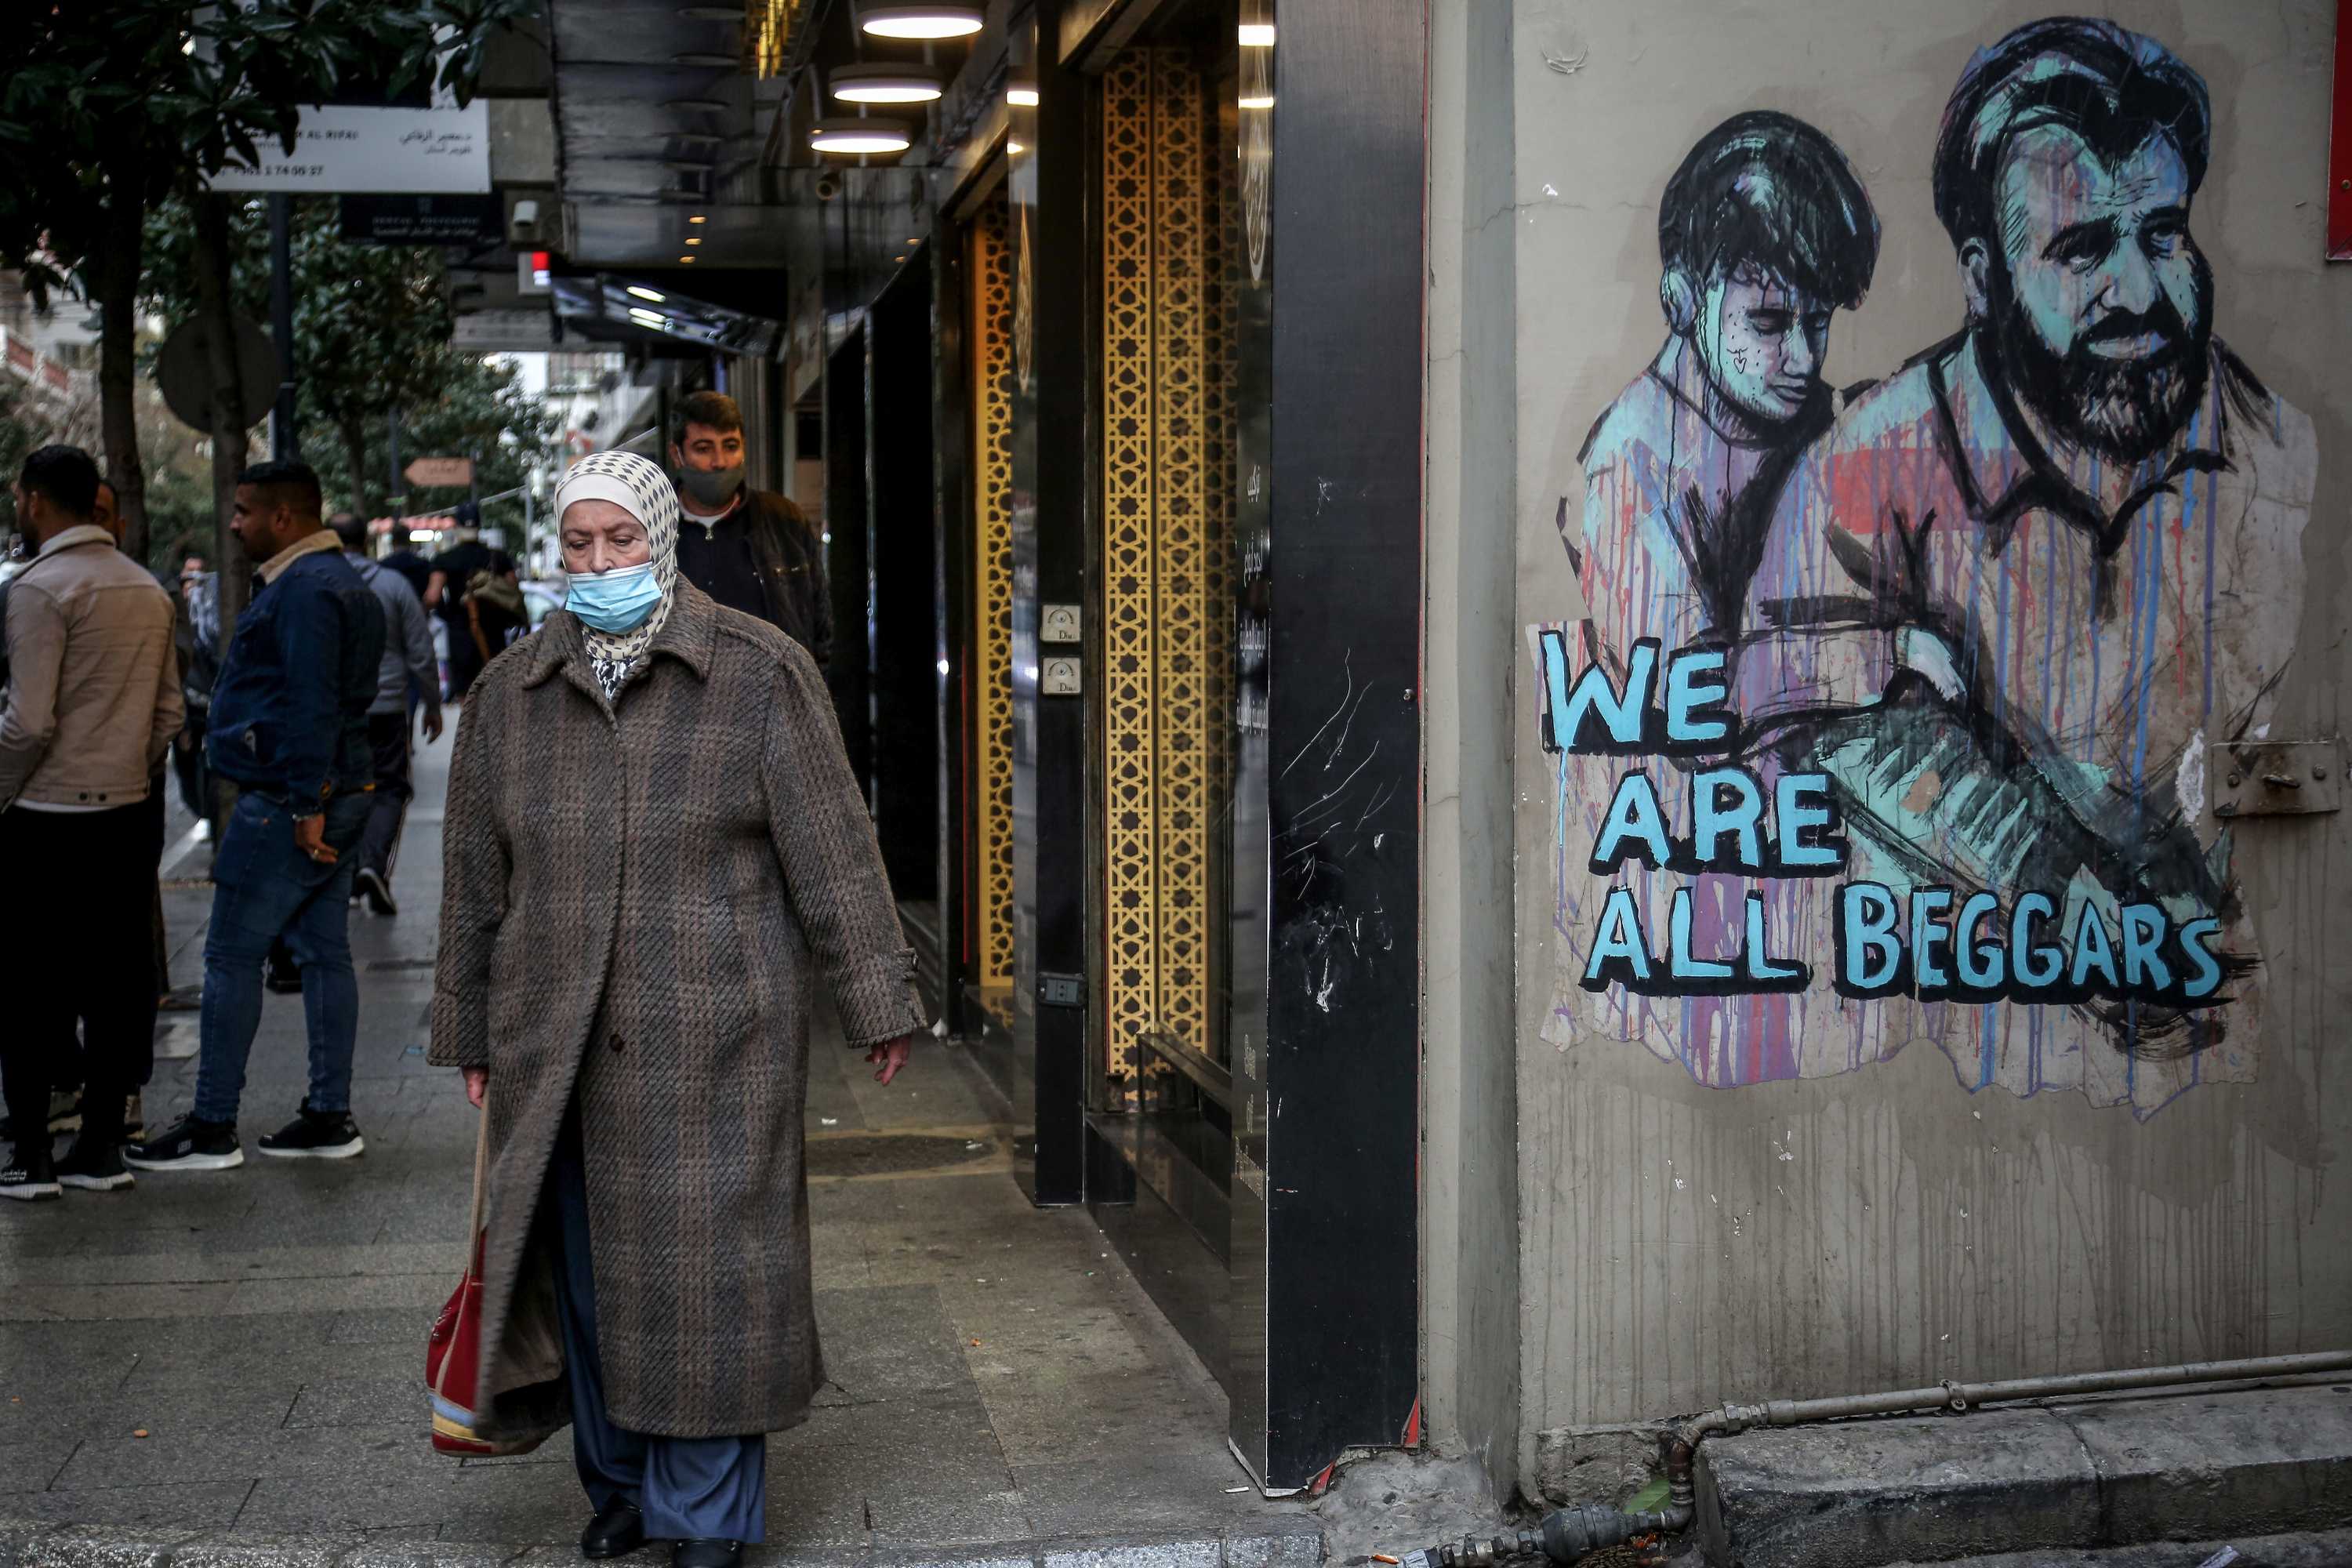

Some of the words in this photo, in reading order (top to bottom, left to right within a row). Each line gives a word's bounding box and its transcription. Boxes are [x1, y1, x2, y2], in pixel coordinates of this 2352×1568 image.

[1539, 630, 1731, 753] WE
[1589, 763, 1850, 877] ARE
[1579, 884, 1813, 994] ALL
[1833, 879, 2230, 1007] BEGGARS
